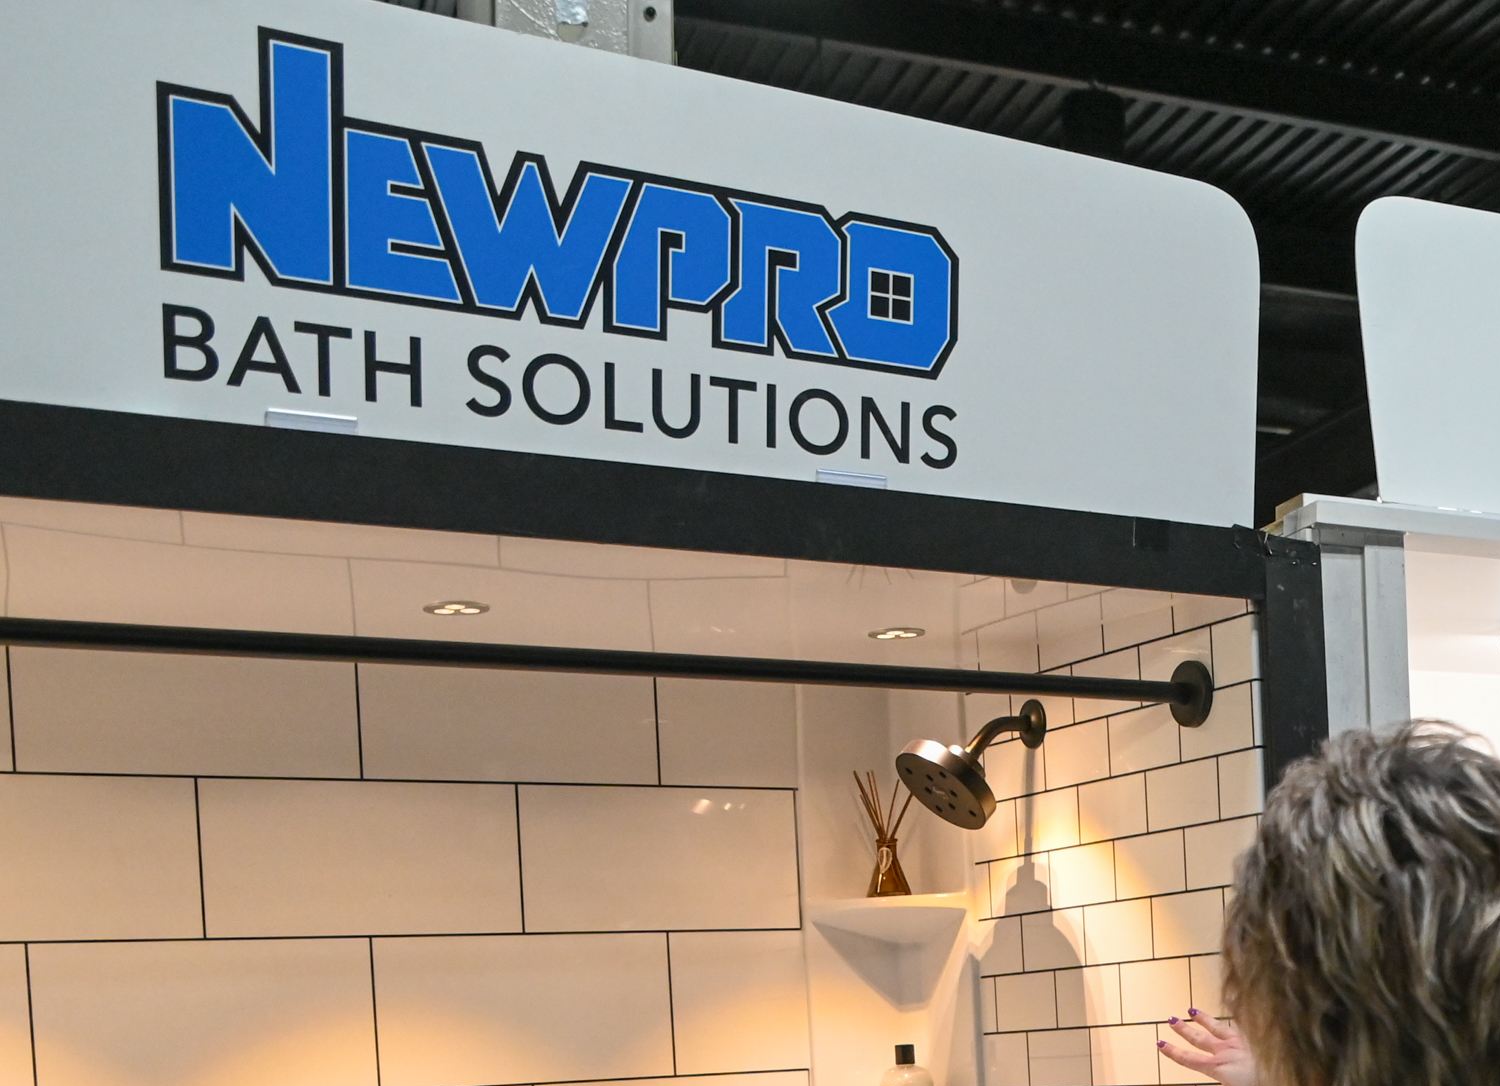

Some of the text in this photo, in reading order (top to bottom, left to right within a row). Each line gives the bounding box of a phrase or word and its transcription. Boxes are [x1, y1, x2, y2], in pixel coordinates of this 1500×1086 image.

[156, 26, 959, 380] NEWPRO
[162, 302, 959, 469] BATH SOLUTIONS
